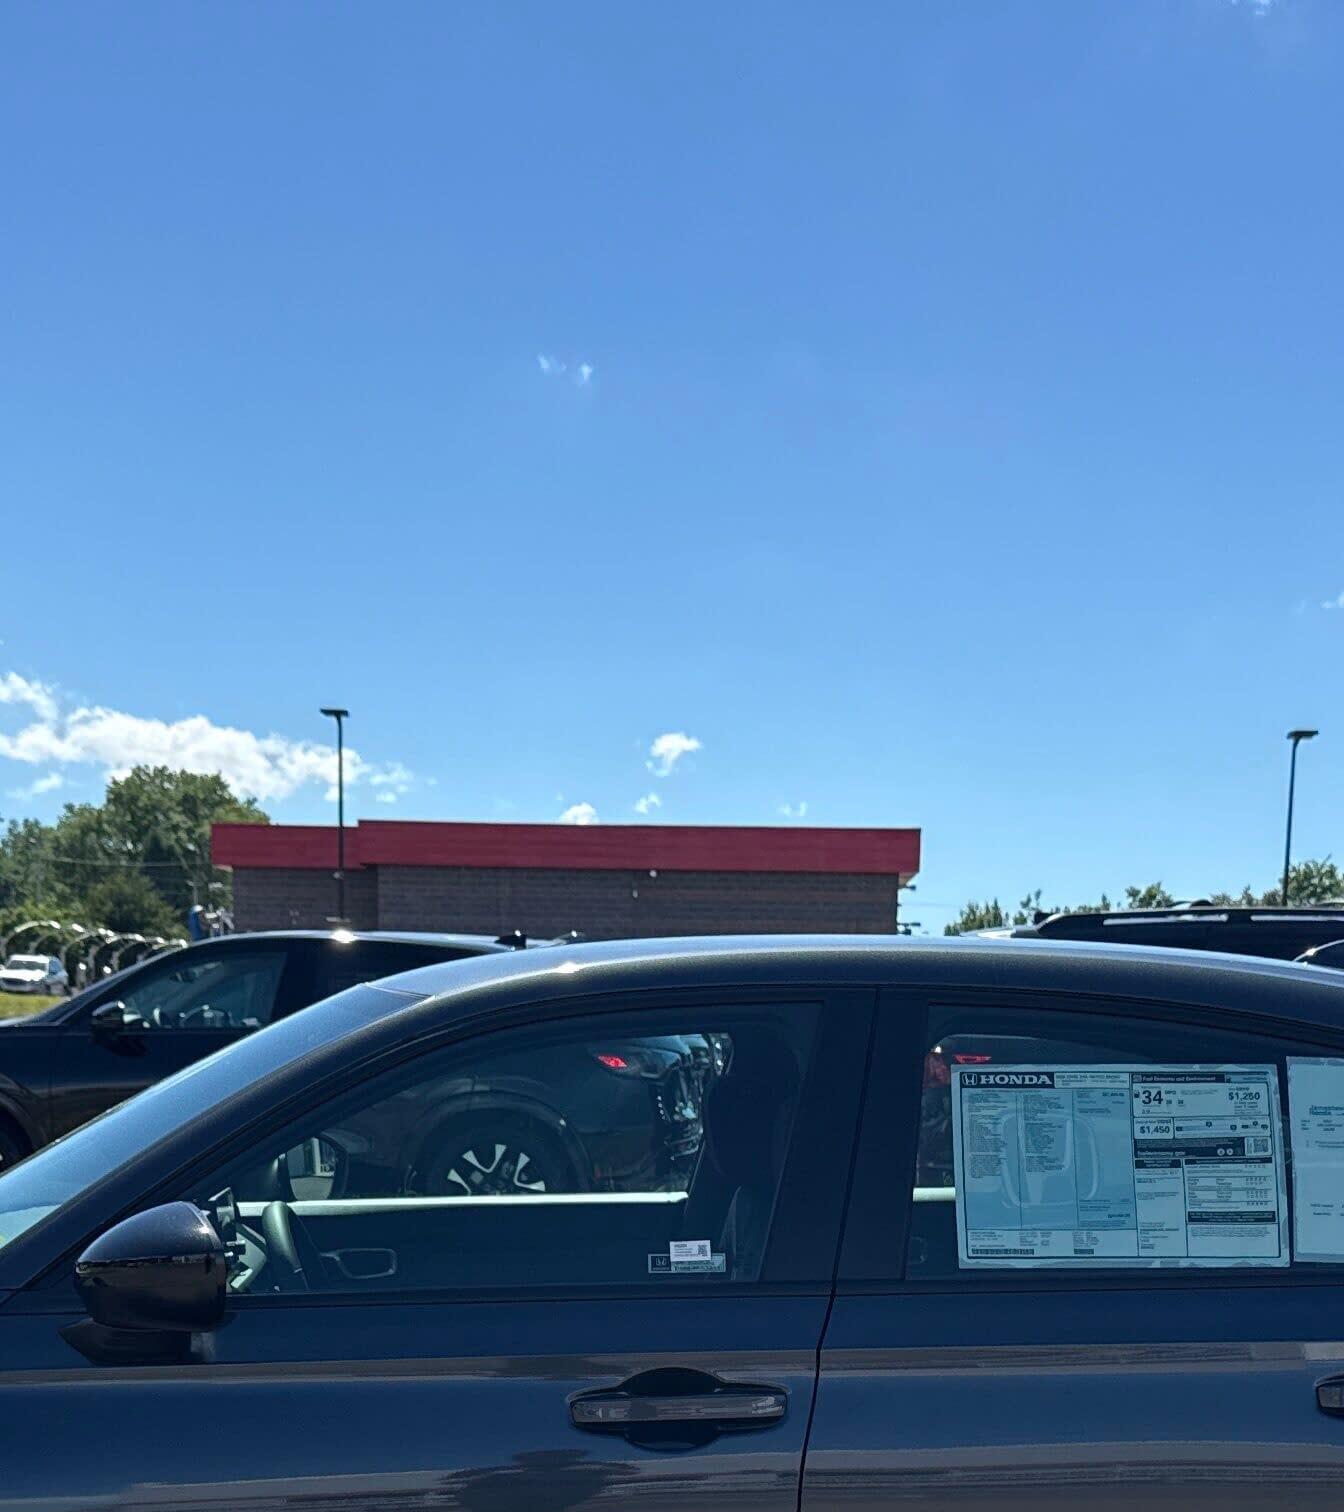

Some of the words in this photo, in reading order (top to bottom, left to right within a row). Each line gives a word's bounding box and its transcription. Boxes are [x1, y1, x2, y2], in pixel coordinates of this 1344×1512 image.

[980, 1074, 1052, 1085] HONDA
[1141, 1089, 1164, 1105] 34
[1228, 1091, 1261, 1101] $1,250
[1139, 1125, 1171, 1134] $1,450
